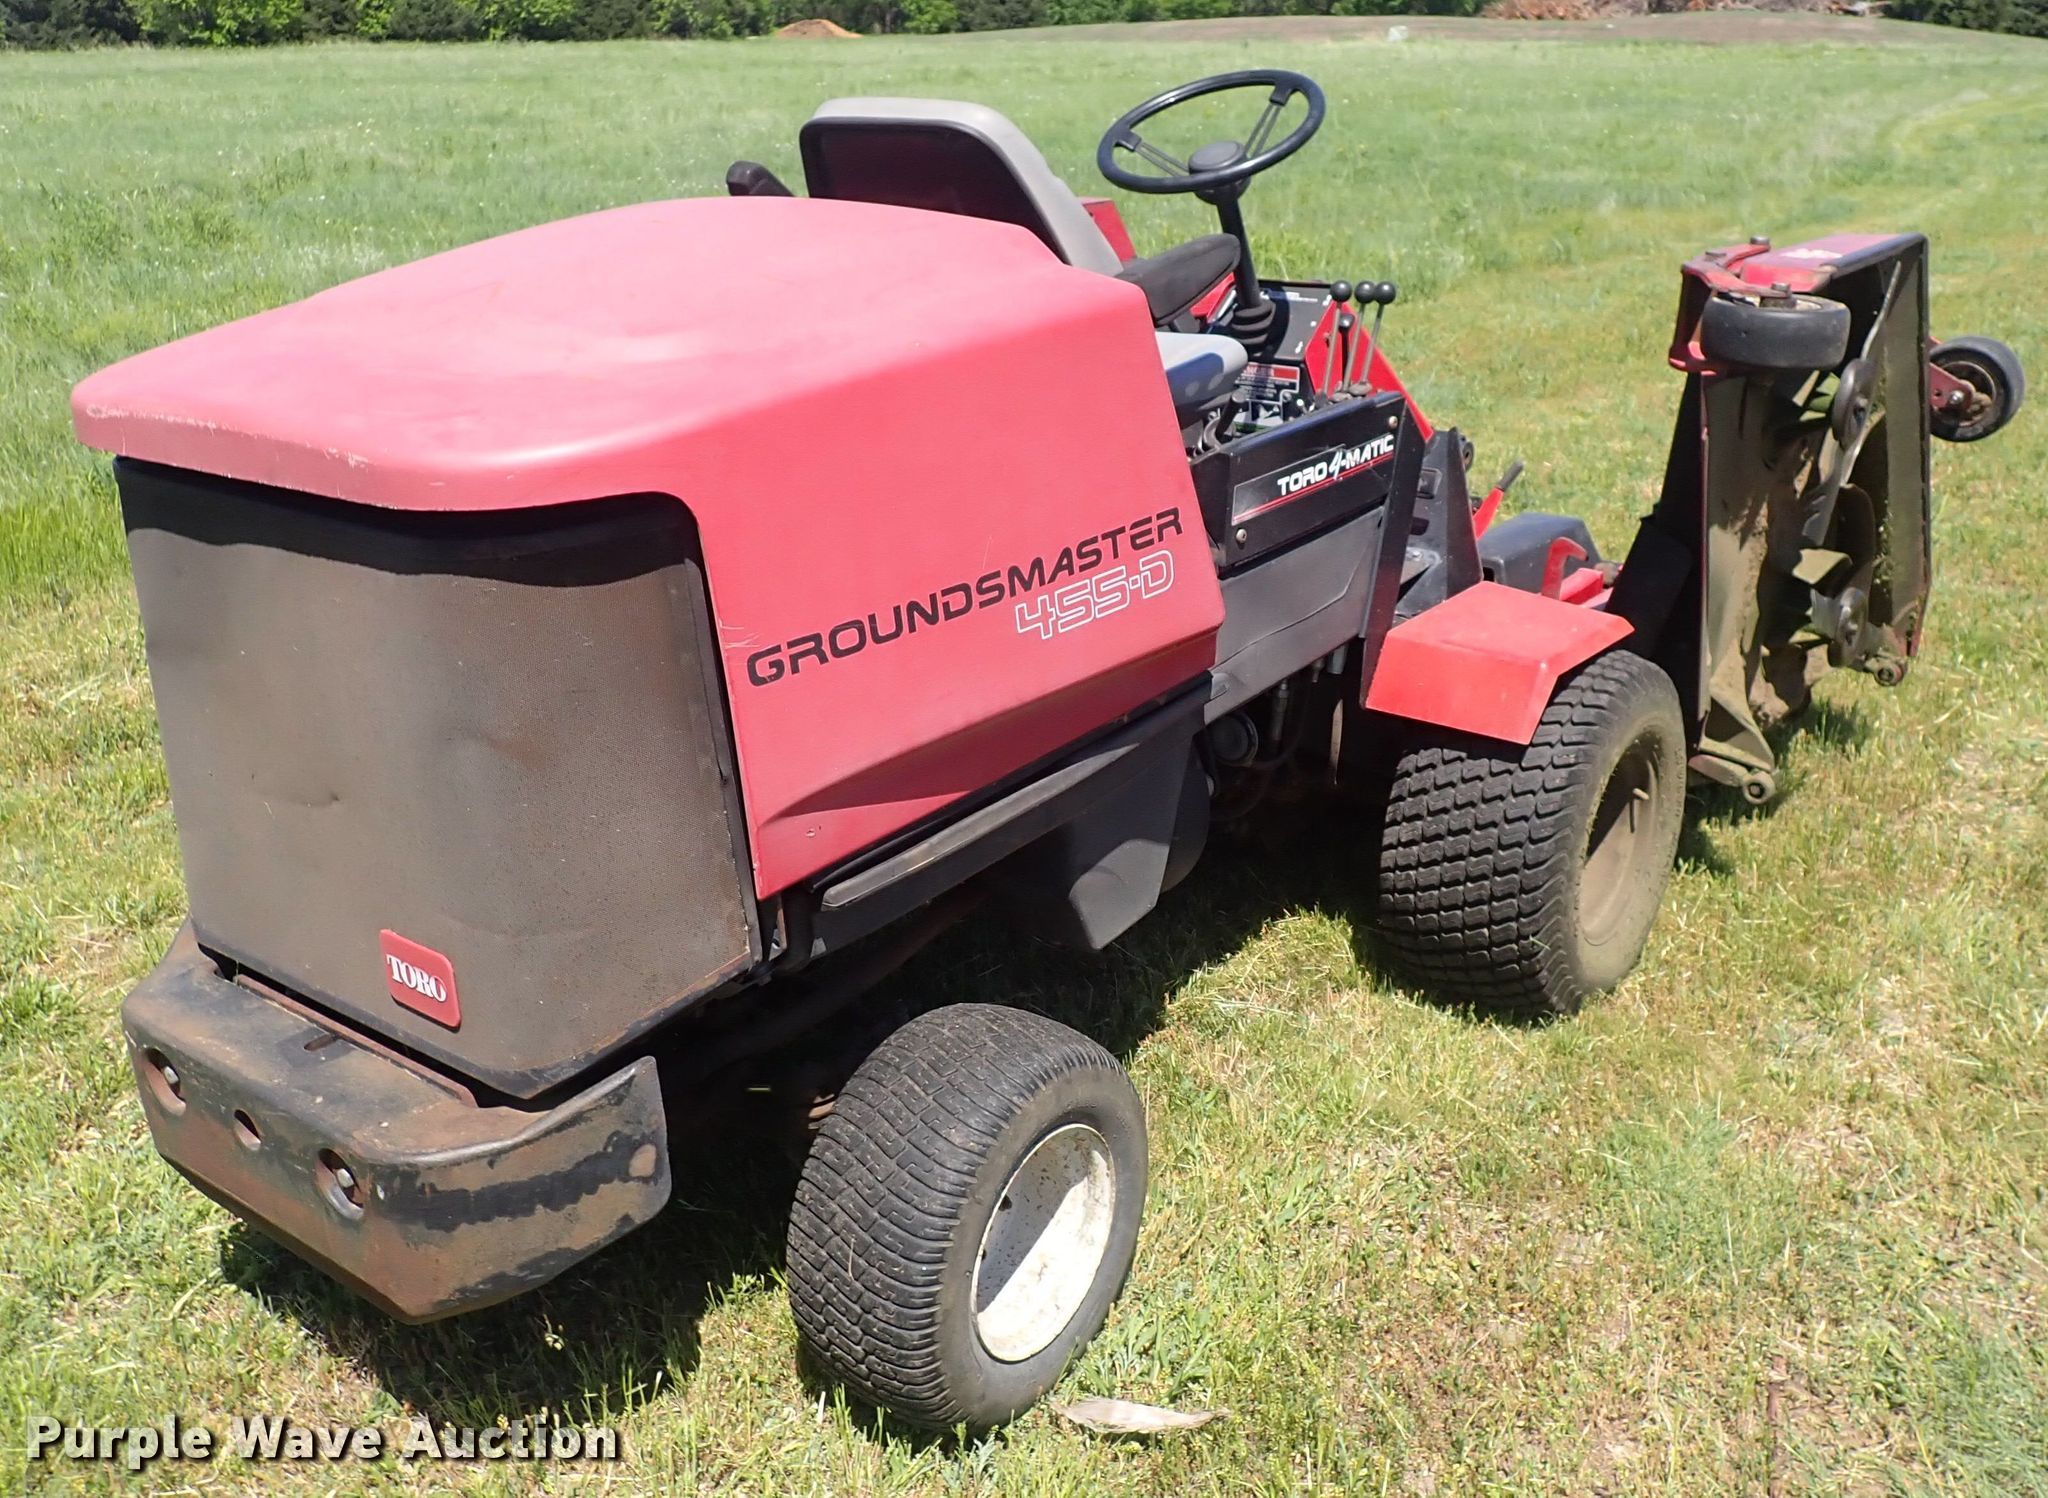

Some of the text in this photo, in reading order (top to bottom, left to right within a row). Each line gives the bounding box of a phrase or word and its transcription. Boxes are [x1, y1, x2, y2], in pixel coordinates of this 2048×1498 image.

[1277, 434, 1395, 496] TORO 4-MATIC
[746, 507, 1183, 688] GROUNDSMASTER
[1014, 549, 1175, 641] 455-D
[386, 954, 448, 1002] TORO
